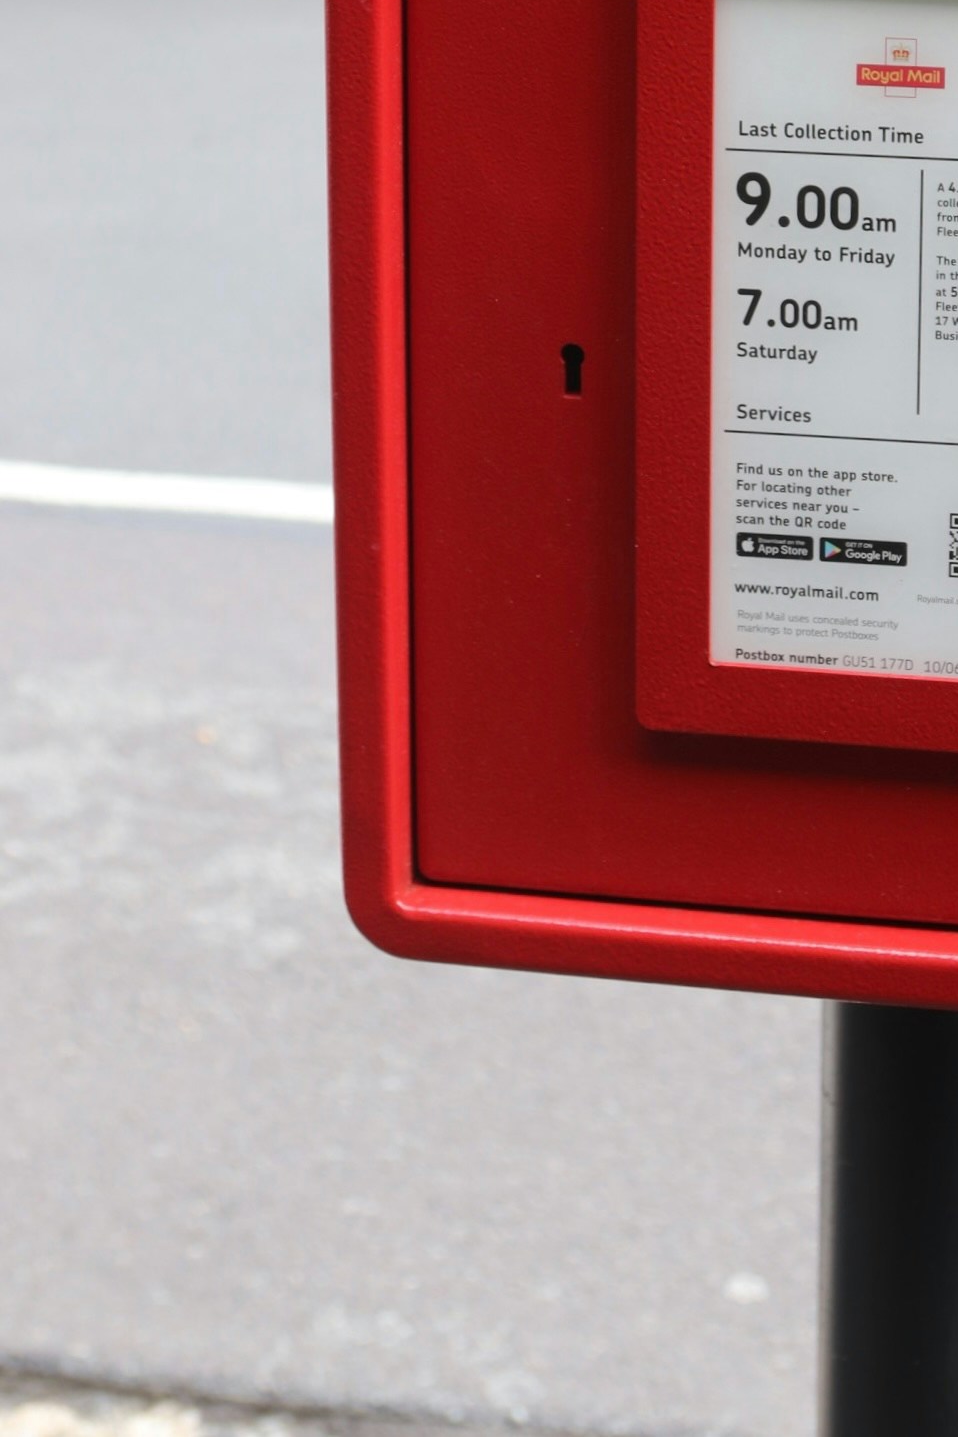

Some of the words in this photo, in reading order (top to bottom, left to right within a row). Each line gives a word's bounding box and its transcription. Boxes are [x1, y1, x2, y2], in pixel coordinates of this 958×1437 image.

[861, 67, 903, 84] Royal
[907, 69, 941, 84] Mail
[739, 120, 778, 138] Last
[784, 122, 872, 142] Collection
[878, 127, 924, 144] Time
[937, 182, 945, 192] A
[736, 171, 897, 233] 9.00am
[737, 242, 807, 263] Monday
[814, 246, 832, 261] to
[839, 247, 895, 267] Friday
[936, 255, 957, 266] The
[936, 271, 946, 281] in
[935, 287, 947, 298] at
[737, 288, 859, 332] 7.00am
[935, 316, 948, 327] 17
[736, 342, 818, 364] Saturday
[736, 404, 812, 424] Services
[736, 462, 764, 476] Find
[768, 465, 783, 477] us
[787, 467, 803, 477] on
[808, 467, 829, 479] the
[833, 470, 857, 483] app
[861, 471, 898, 483] store.
[736, 479, 758, 491] For
[761, 481, 812, 497] locating
[816, 485, 852, 497] other
[735, 497, 788, 510] services
[792, 500, 822, 513] near
[825, 502, 849, 515] you
[735, 514, 765, 526] scan
[769, 516, 790, 527] the
[794, 516, 813, 528] QR
[817, 518, 847, 530] code
[757, 544, 780, 556] App
[780, 545, 809, 556] Store
[845, 549, 881, 562] Google
[881, 550, 903, 564] Play
[734, 583, 880, 602] www.royalmail.com
[737, 609, 763, 621] Royal
[765, 611, 785, 622] Mail
[787, 614, 810, 624] uses
[812, 615, 859, 626] concealed
[861, 618, 899, 631] security
[736, 623, 781, 636] markings
[783, 626, 793, 635] to
[795, 627, 828, 638] protect
[831, 629, 879, 641] Postboxes
[735, 648, 785, 662] Postbox
[788, 653, 839, 666] number
[842, 655, 876, 669] GU51
[880, 657, 914, 671] 177D
